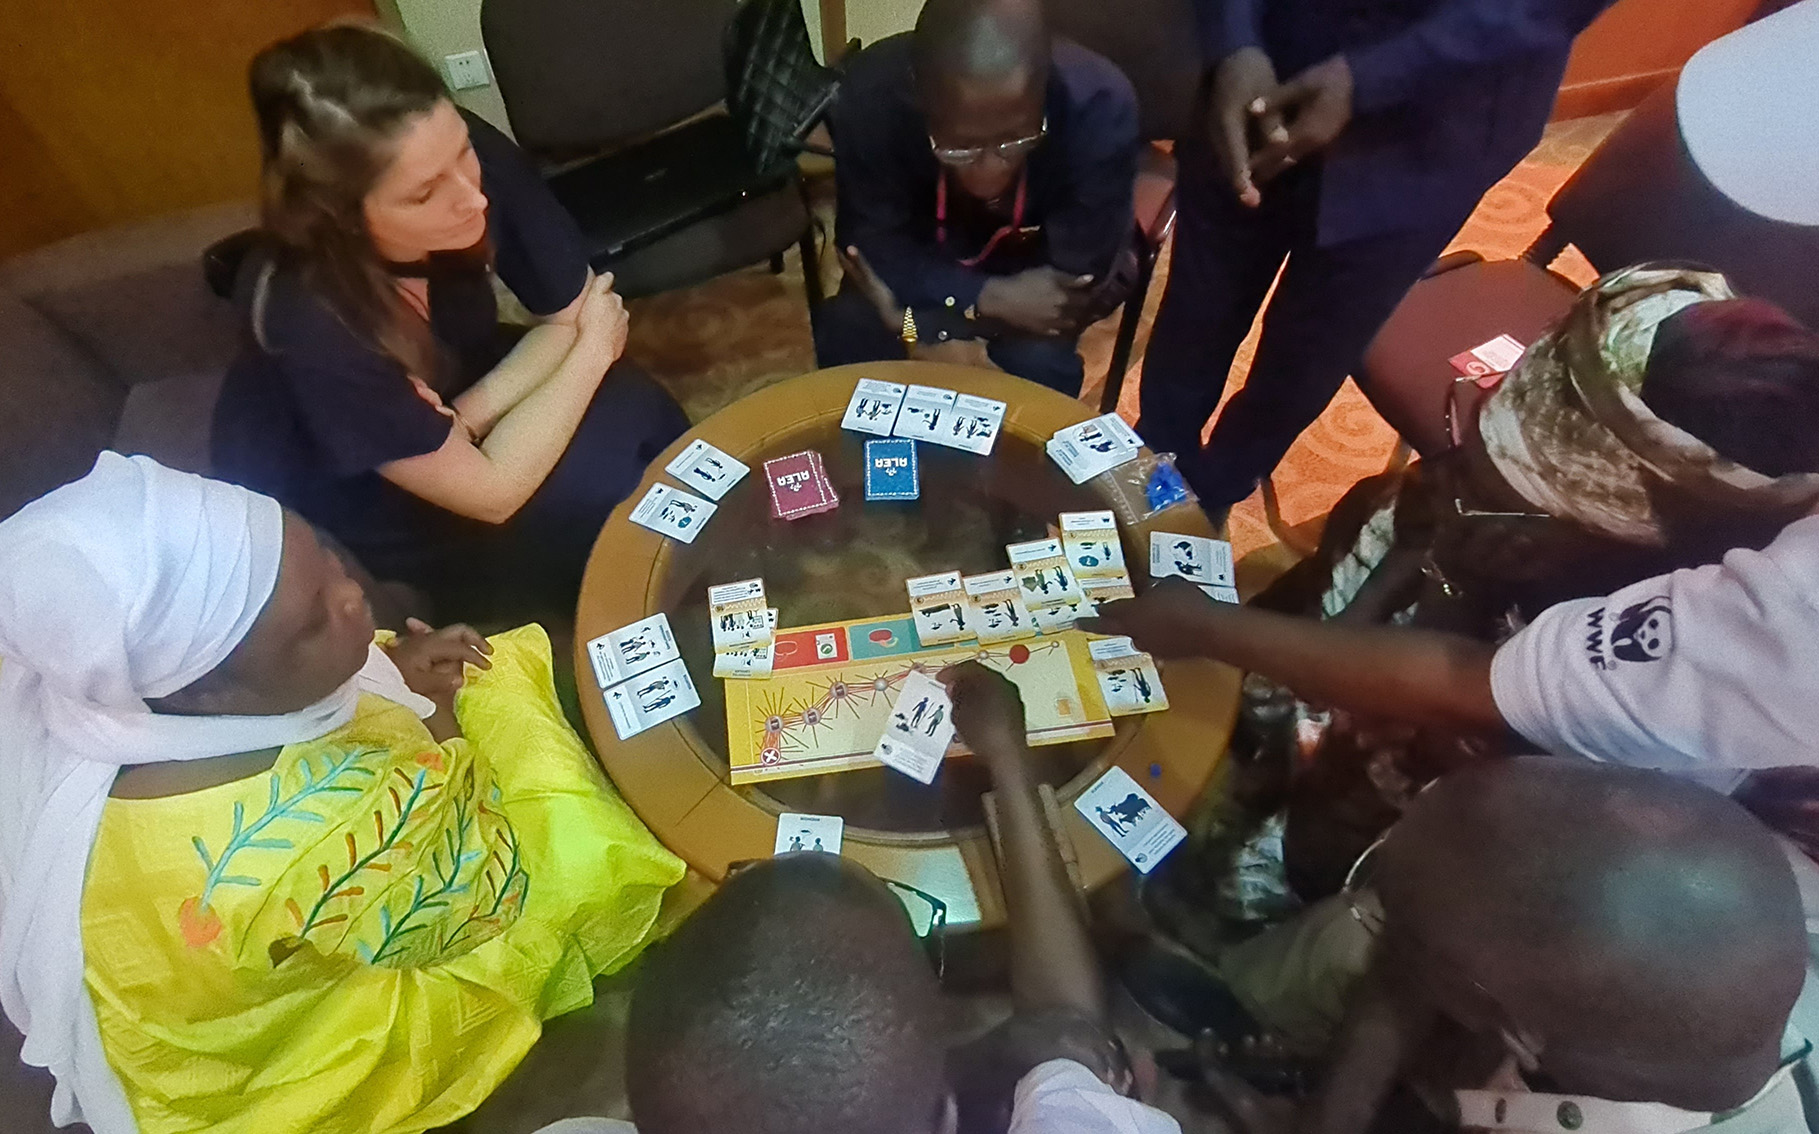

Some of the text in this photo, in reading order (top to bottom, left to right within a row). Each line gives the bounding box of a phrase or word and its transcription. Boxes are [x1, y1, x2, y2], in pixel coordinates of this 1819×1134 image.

[874, 457, 908, 468] ALEA
[776, 469, 811, 487] ALEA
[1586, 607, 1606, 670] WWF
